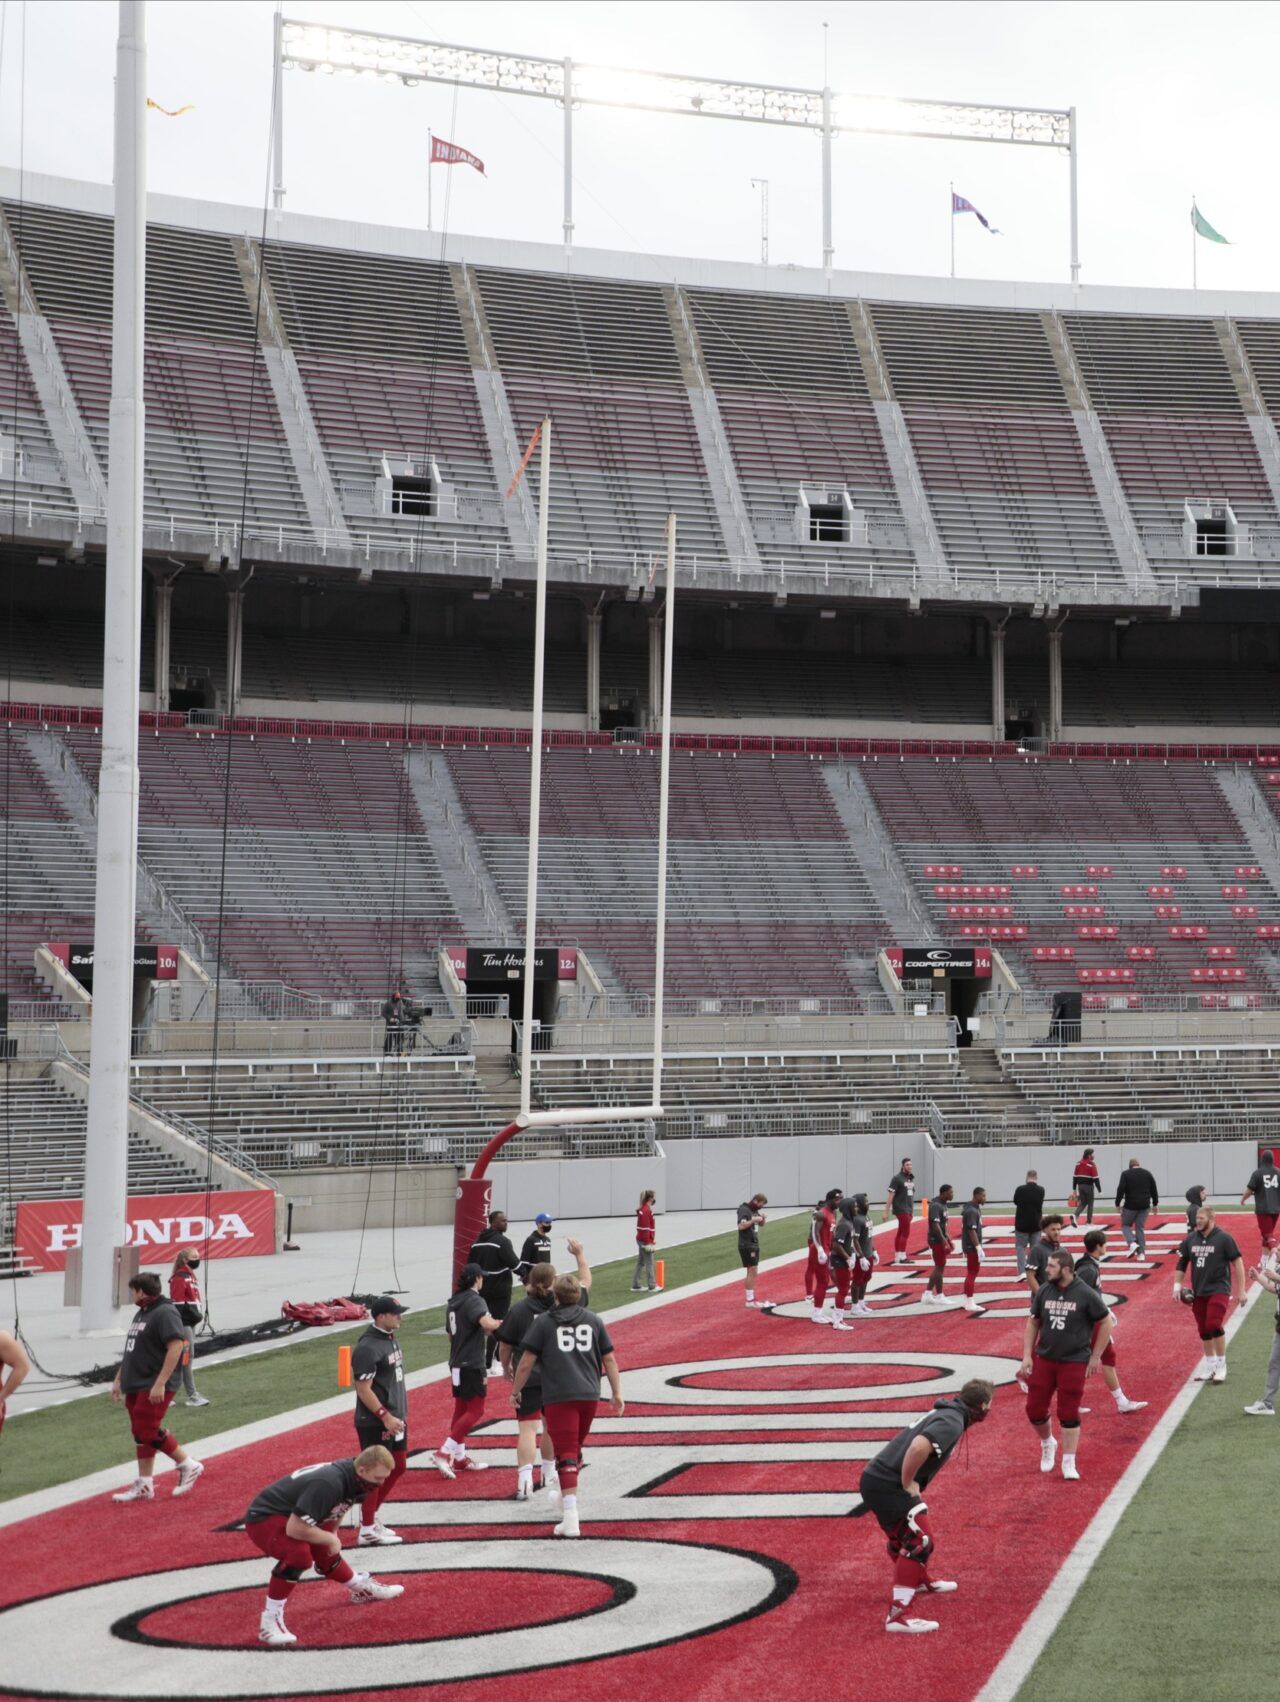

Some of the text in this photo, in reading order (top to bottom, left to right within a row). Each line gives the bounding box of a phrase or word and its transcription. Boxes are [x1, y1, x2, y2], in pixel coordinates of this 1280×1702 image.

[482, 954, 502, 966] Tim
[1263, 1174, 1278, 1188] 54
[1044, 1300, 1077, 1311] NEBRASKA
[1050, 1316, 1065, 1330] 75
[556, 1324, 593, 1352] 69
